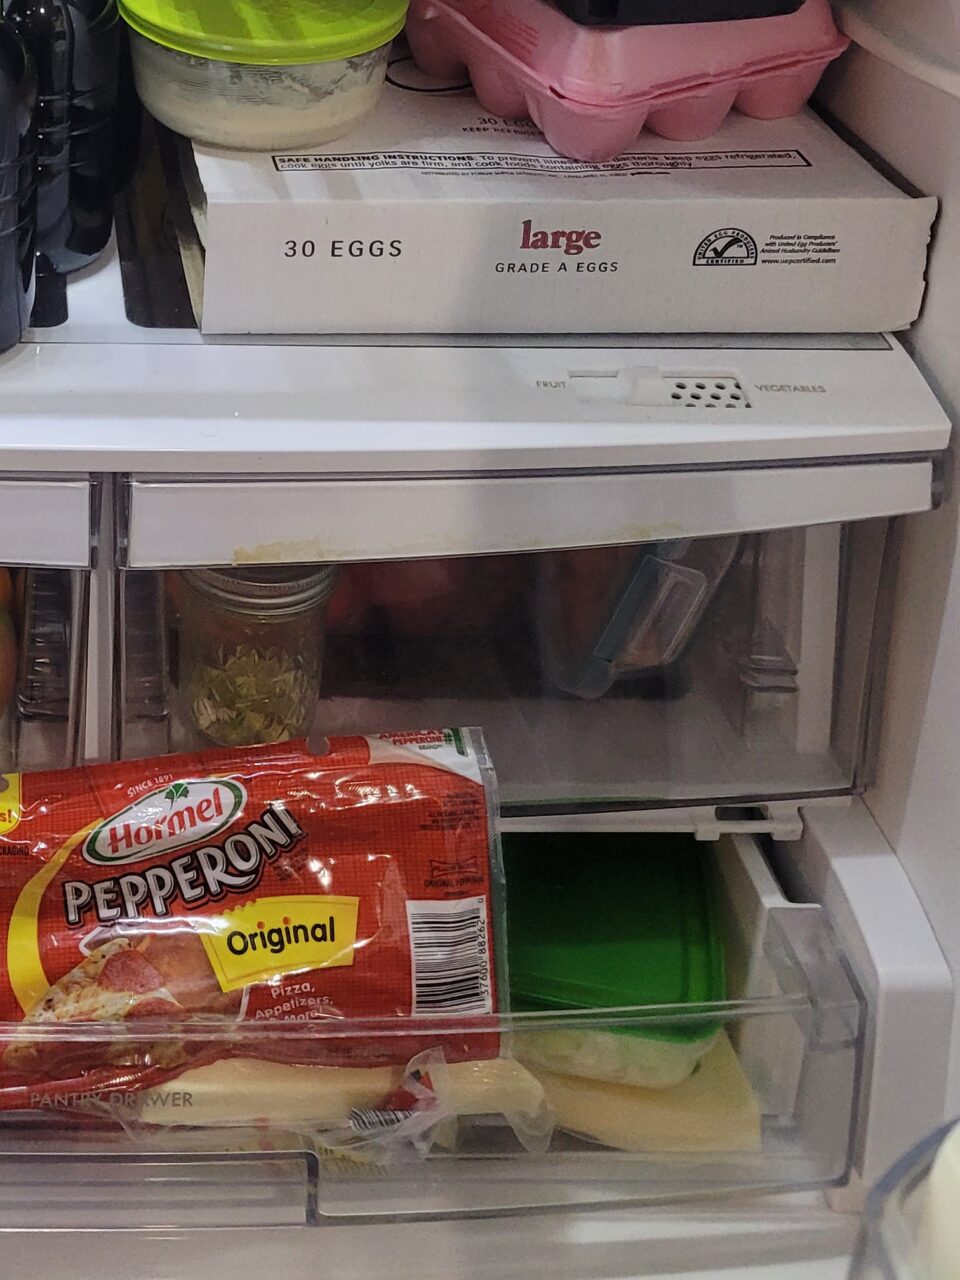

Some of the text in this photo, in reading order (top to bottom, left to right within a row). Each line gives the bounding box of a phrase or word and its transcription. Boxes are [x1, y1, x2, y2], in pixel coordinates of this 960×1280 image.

[280, 162, 308, 170] cook
[340, 161, 366, 169] until
[368, 160, 398, 169] yolks
[421, 160, 449, 168] firm,
[451, 160, 472, 168] and
[474, 160, 501, 168] cook
[539, 162, 601, 172] containing
[314, 154, 380, 163] HANDLING
[497, 155, 541, 164] prevent
[663, 154, 693, 162] keep
[520, 219, 602, 256] large
[714, 230, 729, 239] EGG
[802, 234, 836, 242] Compliance
[284, 240, 404, 258] 30 EGGS
[781, 247, 810, 255] Husbandry
[797, 241, 807, 249] Egg
[495, 261, 619, 273] GRADE A EGGS
[761, 257, 837, 266] www.uepcertified.com
[536, 380, 827, 393] FRUIT VEGETABLES
[392, 734, 443, 746] PEPPERONI
[126, 773, 174, 799] SINCE 1891
[107, 787, 224, 854] Hormel
[63, 804, 304, 925] PEPPERONI
[226, 915, 336, 956] Original
[477, 919, 487, 955] 88262
[479, 960, 489, 996] 37600
[271, 981, 316, 999] Pizza,
[255, 995, 334, 1020] Appetizers,
[30, 1091, 194, 1108] PANTRY DRAWER
